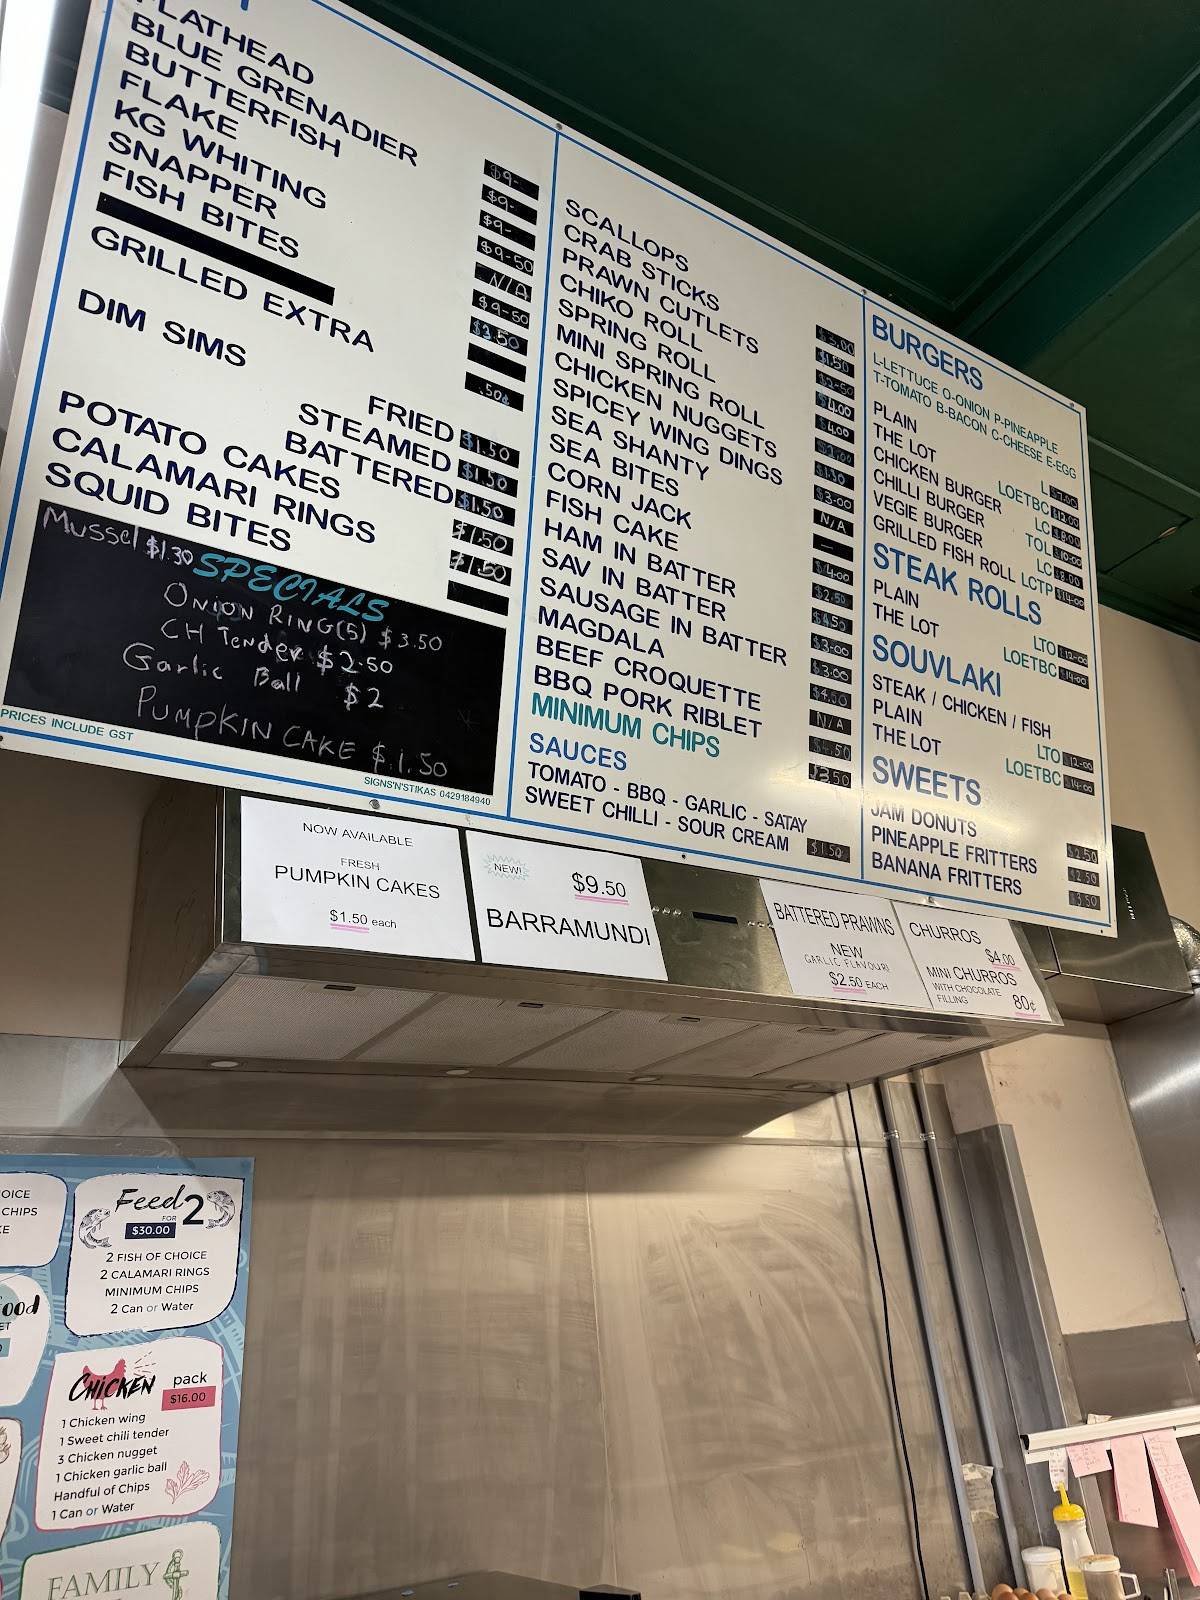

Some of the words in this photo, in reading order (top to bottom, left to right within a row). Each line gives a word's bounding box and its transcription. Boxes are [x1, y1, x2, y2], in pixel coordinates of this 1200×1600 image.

[120, 70, 238, 140] FLAKE
[126, 41, 340, 157] BUTTERFISH
[131, 12, 223, 71] BLUE
[238, 66, 417, 167] GRENADIER
[114, 100, 165, 137] KG
[182, 128, 326, 208] WHITING
[108, 132, 276, 219] SNAPPER
[103, 161, 184, 212] FISH
[201, 202, 298, 258] BITES
[566, 199, 688, 272] SCALLOPS
[564, 224, 631, 268] CRAB
[642, 262, 719, 311] STICKS
[91, 226, 247, 300] GRILLED
[264, 292, 374, 352] EXTRA
[563, 248, 649, 302] PRAWN
[660, 296, 758, 354] CUTLETS
[873, 314, 983, 390] BURGERS
[557, 324, 604, 359] MINI
[616, 351, 699, 400] SPRING
[710, 391, 765, 429] ROLL
[368, 396, 454, 442] FRIED
[555, 352, 662, 411] CHICKEN
[673, 401, 776, 458] NUGGETS
[874, 352, 938, 394] L-LETTUCE
[942, 388, 990, 420] O-ONION
[994, 413, 1058, 454] P-PINEAPPLE
[874, 401, 916, 434] PLAIN
[59, 391, 206, 454] POTATO
[224, 446, 339, 498] CAKES
[299, 403, 451, 472] STEAMED
[552, 406, 602, 441] SEA
[613, 430, 709, 480] SHANTY
[553, 378, 640, 426] SPICEY
[650, 417, 709, 455] WING
[720, 446, 782, 485] DINGS
[873, 370, 931, 407] T-TOMATO
[936, 401, 987, 436] B-BACON
[992, 429, 1043, 463] C-CHEESE
[1046, 456, 1076, 479] E-EGG
[873, 422, 903, 448] THE
[910, 439, 936, 462] LOT
[53, 428, 256, 507] CALAMARI
[274, 494, 375, 543] RINGS
[874, 446, 938, 486] CHICKEN
[946, 477, 1002, 514] BURGER
[998, 480, 1049, 515] LOETBC
[46, 462, 169, 515] SQUID
[187, 503, 290, 551] BITES
[820, 512, 846, 533] N/A
[147, 535, 194, 565] $1.30
[193, 553, 389, 621] SPECIALS
[874, 543, 958, 596] STEAK
[969, 578, 1041, 625] ROLLS
[161, 619, 203, 643] CH
[538, 606, 664, 658] MAGDALA
[540, 577, 660, 628] SAUSAGE
[671, 616, 691, 638] IN
[703, 626, 786, 666] BATTER
[873, 634, 1000, 697] SOUVLAKI
[1034, 636, 1056, 656] LTO
[123, 642, 222, 680] Garlic
[254, 667, 300, 692] Ball
[534, 665, 592, 699] BBQ
[604, 683, 672, 717] PORK
[684, 703, 762, 738] RIBLET
[873, 674, 926, 704] STEAK
[943, 695, 1006, 726] CHICKEN
[1022, 718, 1050, 740] FISH
[1, 709, 46, 725] PRICES
[51, 718, 104, 736] INCLUDE
[109, 729, 134, 741] GST
[283, 726, 356, 759] CAKE
[532, 692, 641, 740] MINIMUM
[653, 723, 720, 757] CHIPS
[530, 733, 626, 770] SAUCES
[528, 761, 606, 792] TOMATO
[628, 782, 666, 806] BBQ
[685, 795, 746, 821] GARLIC
[764, 812, 807, 833] SATAY
[873, 756, 981, 806] SWEETS
[304, 823, 337, 836] NOW
[342, 829, 412, 846] AVAILABLE
[526, 786, 595, 814] SWEET
[602, 802, 657, 826] CHILLI
[678, 816, 725, 839] SOUR
[732, 827, 788, 852] CREAM
[912, 809, 976, 837] DONUTS
[341, 858, 379, 870] FRESH
[494, 863, 521, 874] NEW!
[872, 826, 959, 859] PINEAPPLE
[966, 845, 1037, 874] FRITTERS
[276, 866, 369, 889] PUMPKIN
[377, 878, 440, 898] CAKES
[572, 872, 626, 897] $9.50
[872, 852, 941, 881] BANANA
[948, 867, 1022, 895] FRITTERS
[330, 910, 367, 924] $1.50
[372, 920, 396, 928] each
[487, 908, 650, 945] BARRAMUNDI
[774, 902, 840, 928] BATTERED
[840, 913, 894, 935] PRAWNS
[910, 922, 981, 944] CHURROS
[804, 954, 840, 966] GARLIC
[844, 959, 890, 973] FLAVOUR!
[830, 943, 862, 958] NEW
[985, 948, 1015, 966] $4.00
[829, 972, 862, 987] $2.50
[865, 981, 888, 990] EACH
[926, 966, 951, 978] MINI
[953, 966, 1017, 986] CHURROS
[932, 982, 954, 992] WITH
[942, 983, 1002, 996] CHOCOLATE
[936, 994, 968, 1004] FILLING
[1012, 994, 1036, 1013] 80¢
[2, 1208, 37, 1216] CHIPS
[115, 1184, 186, 1213] Feed
[182, 1194, 204, 1225] 2
[131, 1225, 170, 1236] $30.00
[100, 1270, 107, 1279] 2
[112, 1269, 171, 1279] CALAMARI
[176, 1267, 209, 1276] RINGS
[106, 1252, 113, 1262] 2
[118, 1253, 142, 1262] FISH
[146, 1253, 161, 1261] OF
[165, 1251, 206, 1260] CHOICE
[106, 1286, 162, 1296] MINIMUM
[166, 1284, 198, 1294] CHIPS
[111, 1304, 118, 1314] 2
[122, 1305, 142, 1313] Can
[147, 1303, 159, 1313] or
[162, 1302, 194, 1311] Water
[170, 1391, 206, 1404] $16.00
[174, 1372, 206, 1388] pack
[62, 1420, 65, 1428] 1
[70, 1416, 114, 1427] Chicken
[119, 1414, 145, 1424] wing
[58, 1455, 64, 1464] 3
[68, 1451, 114, 1463] Chicken
[118, 1446, 157, 1459] nugget
[48, 1562, 159, 1600] FAMILY
